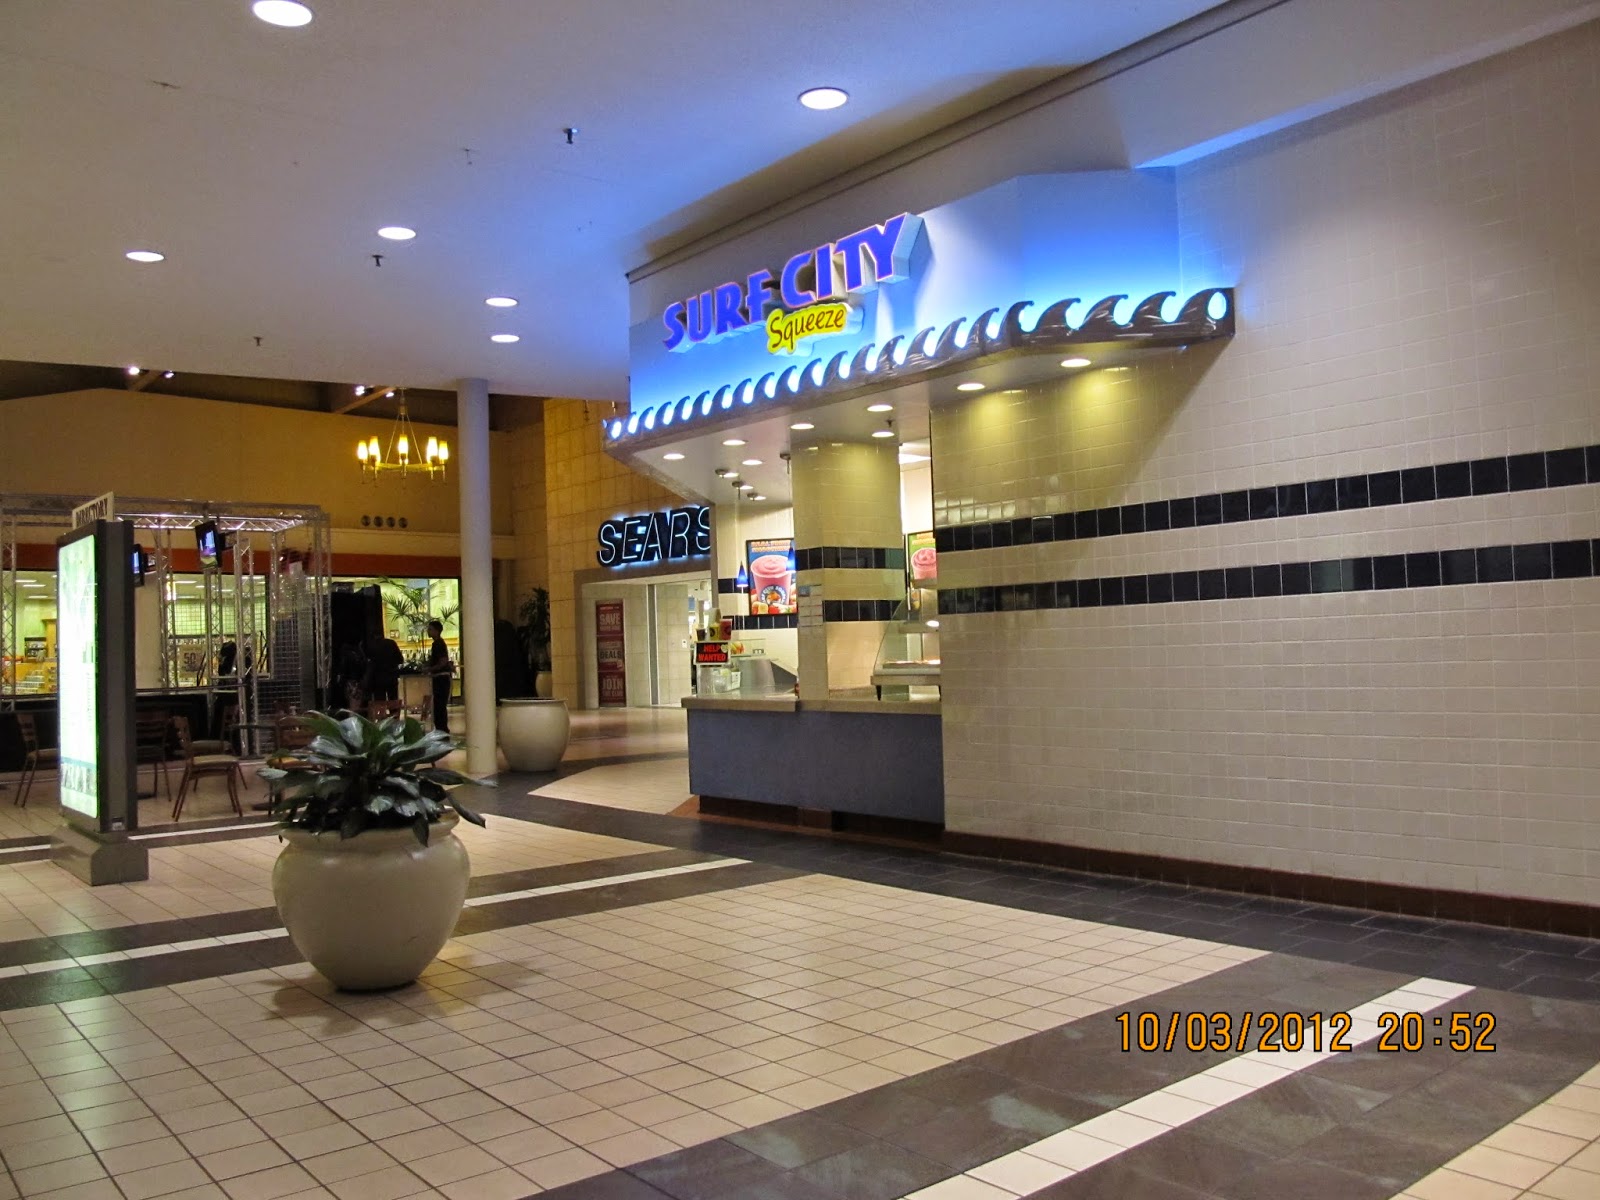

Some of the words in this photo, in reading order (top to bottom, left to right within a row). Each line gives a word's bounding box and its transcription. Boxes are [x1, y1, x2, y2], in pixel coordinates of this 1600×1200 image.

[663, 269, 774, 351] SURF
[780, 212, 909, 309] CITY
[769, 307, 845, 349] Squeeze
[76, 497, 107, 528] DIRECTORY
[597, 506, 710, 568] SEARS
[600, 612, 621, 625] SAVE
[599, 650, 622, 659] DEALS
[698, 653, 726, 662] WANTED
[703, 644, 721, 653] HELP
